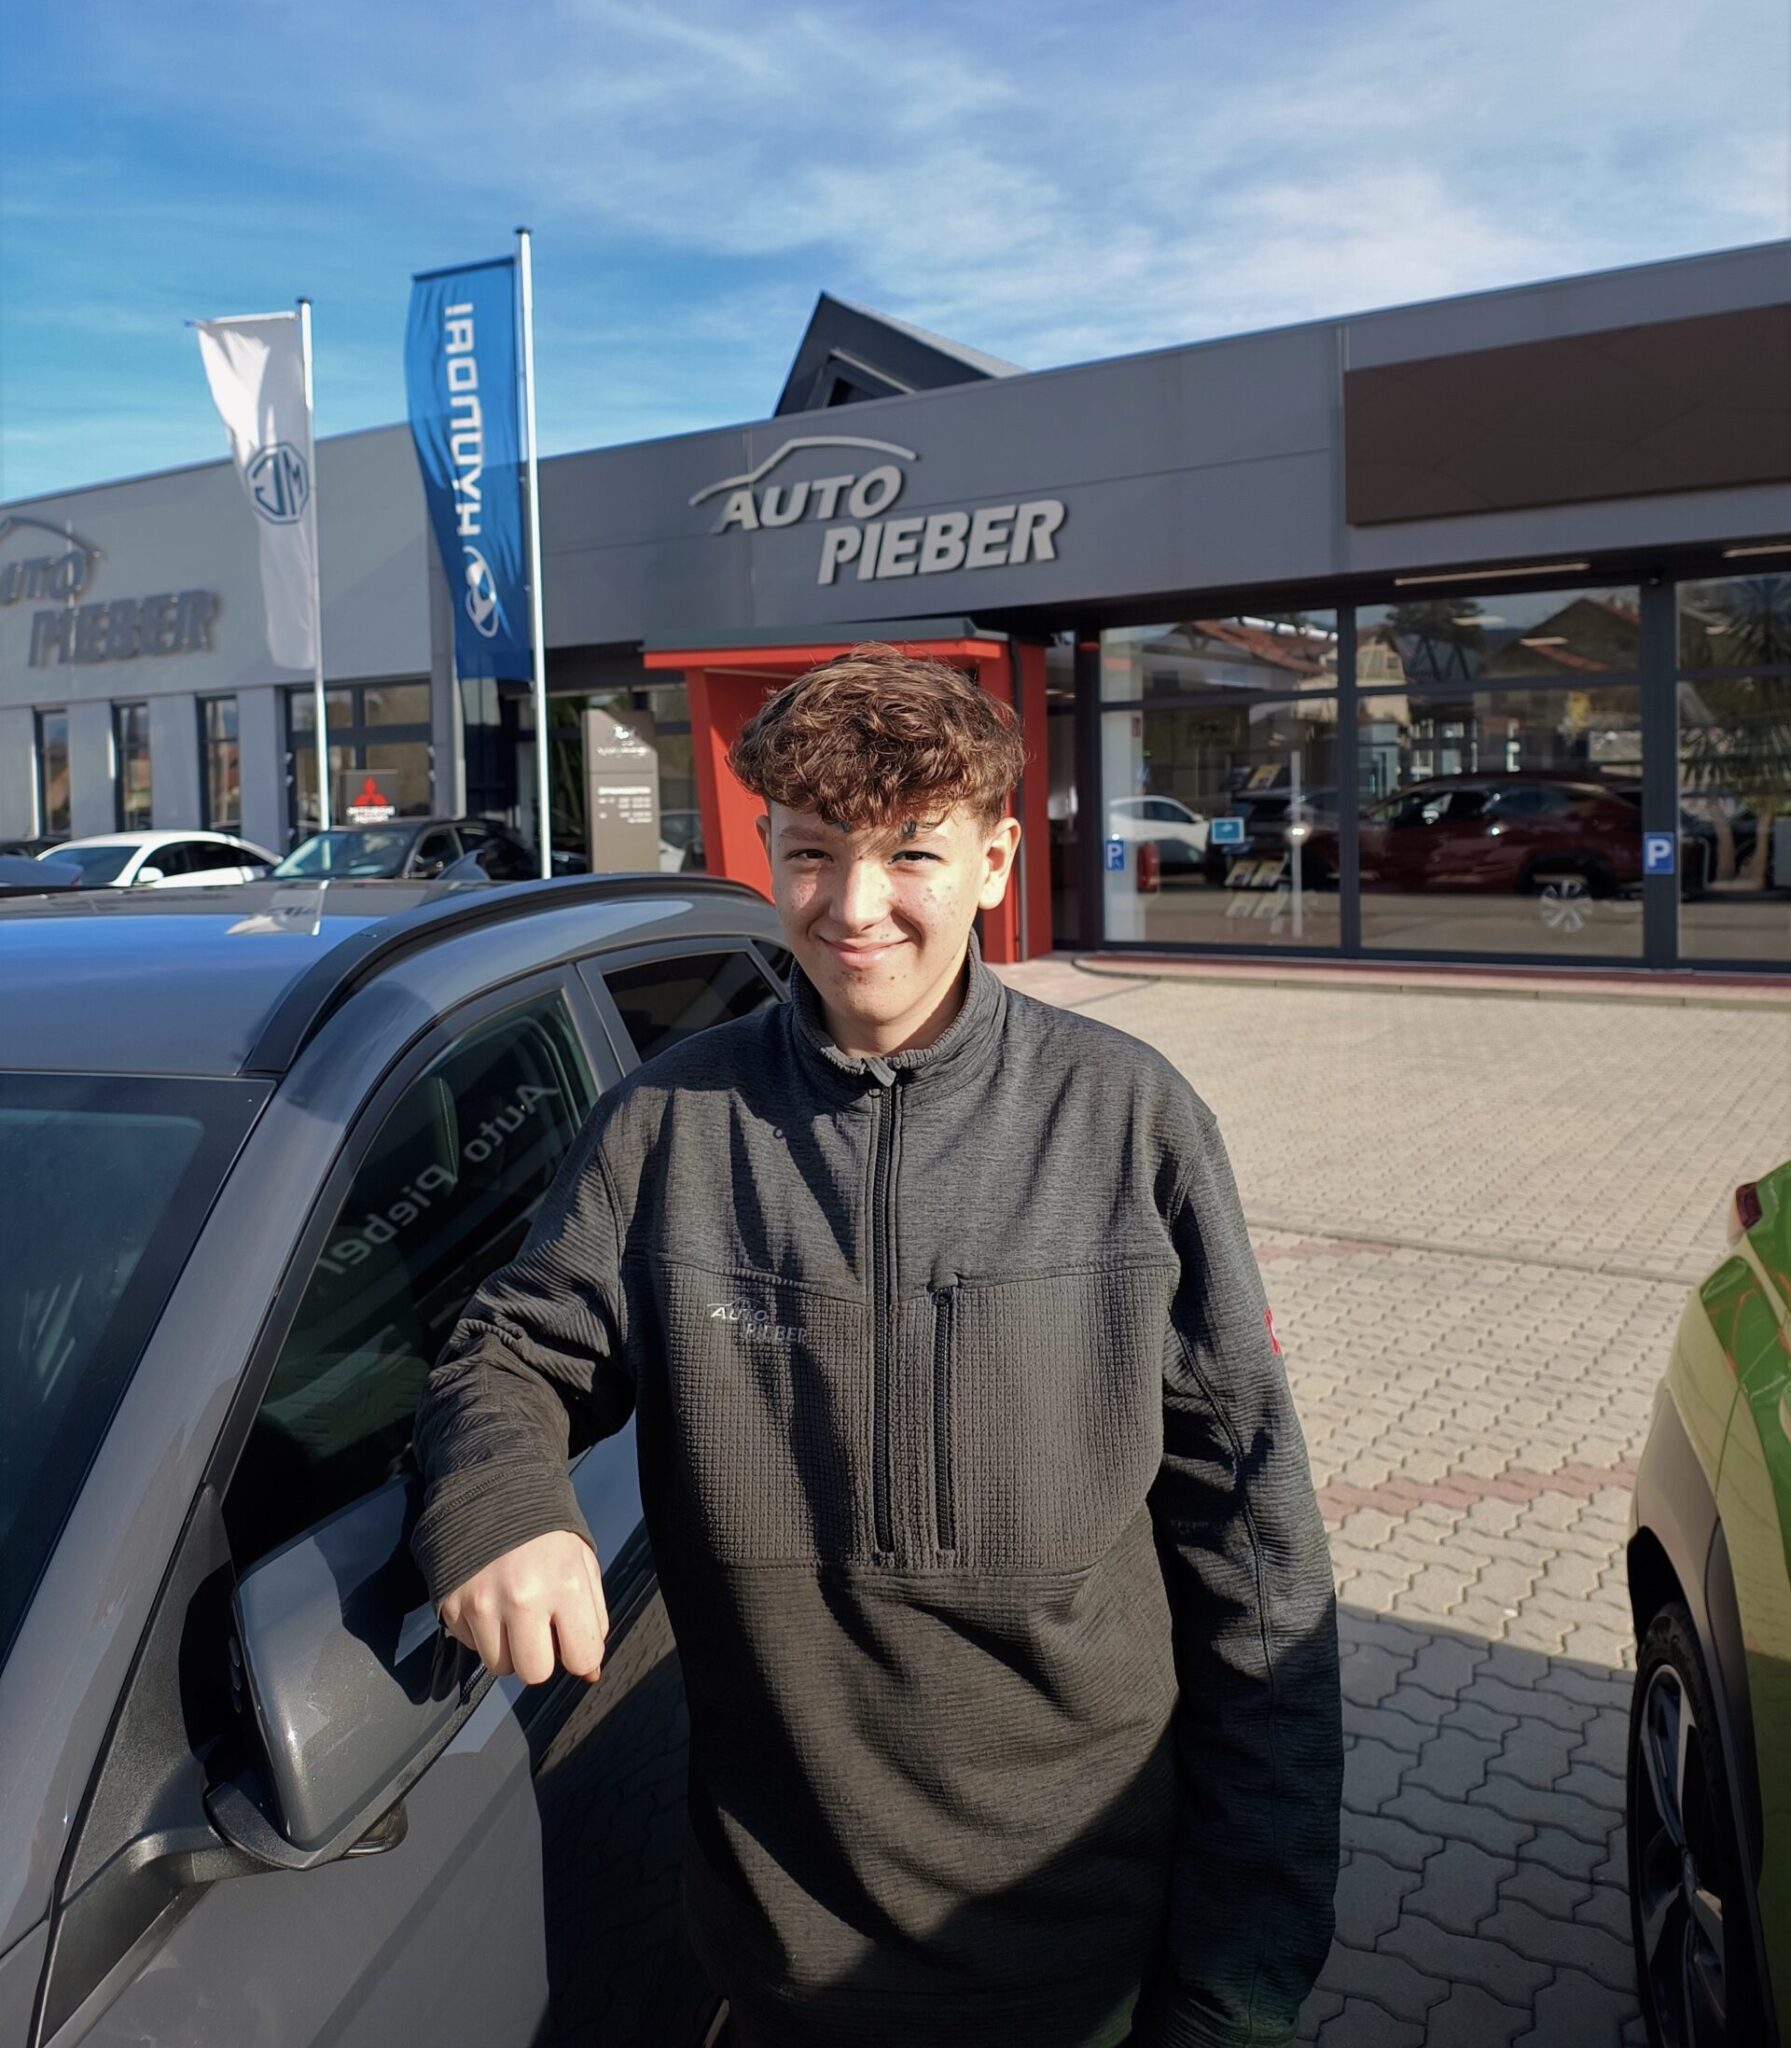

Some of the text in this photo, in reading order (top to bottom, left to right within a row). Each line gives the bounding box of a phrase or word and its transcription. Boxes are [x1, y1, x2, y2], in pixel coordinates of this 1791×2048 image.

[710, 465, 902, 535] AUTO
[817, 499, 1065, 586] PIEBER
[0, 552, 86, 605] UTO
[28, 590, 216, 667] PIEBER
[1107, 843, 1122, 868] P
[1648, 838, 1671, 868] P
[711, 1306, 767, 1321] AUTO
